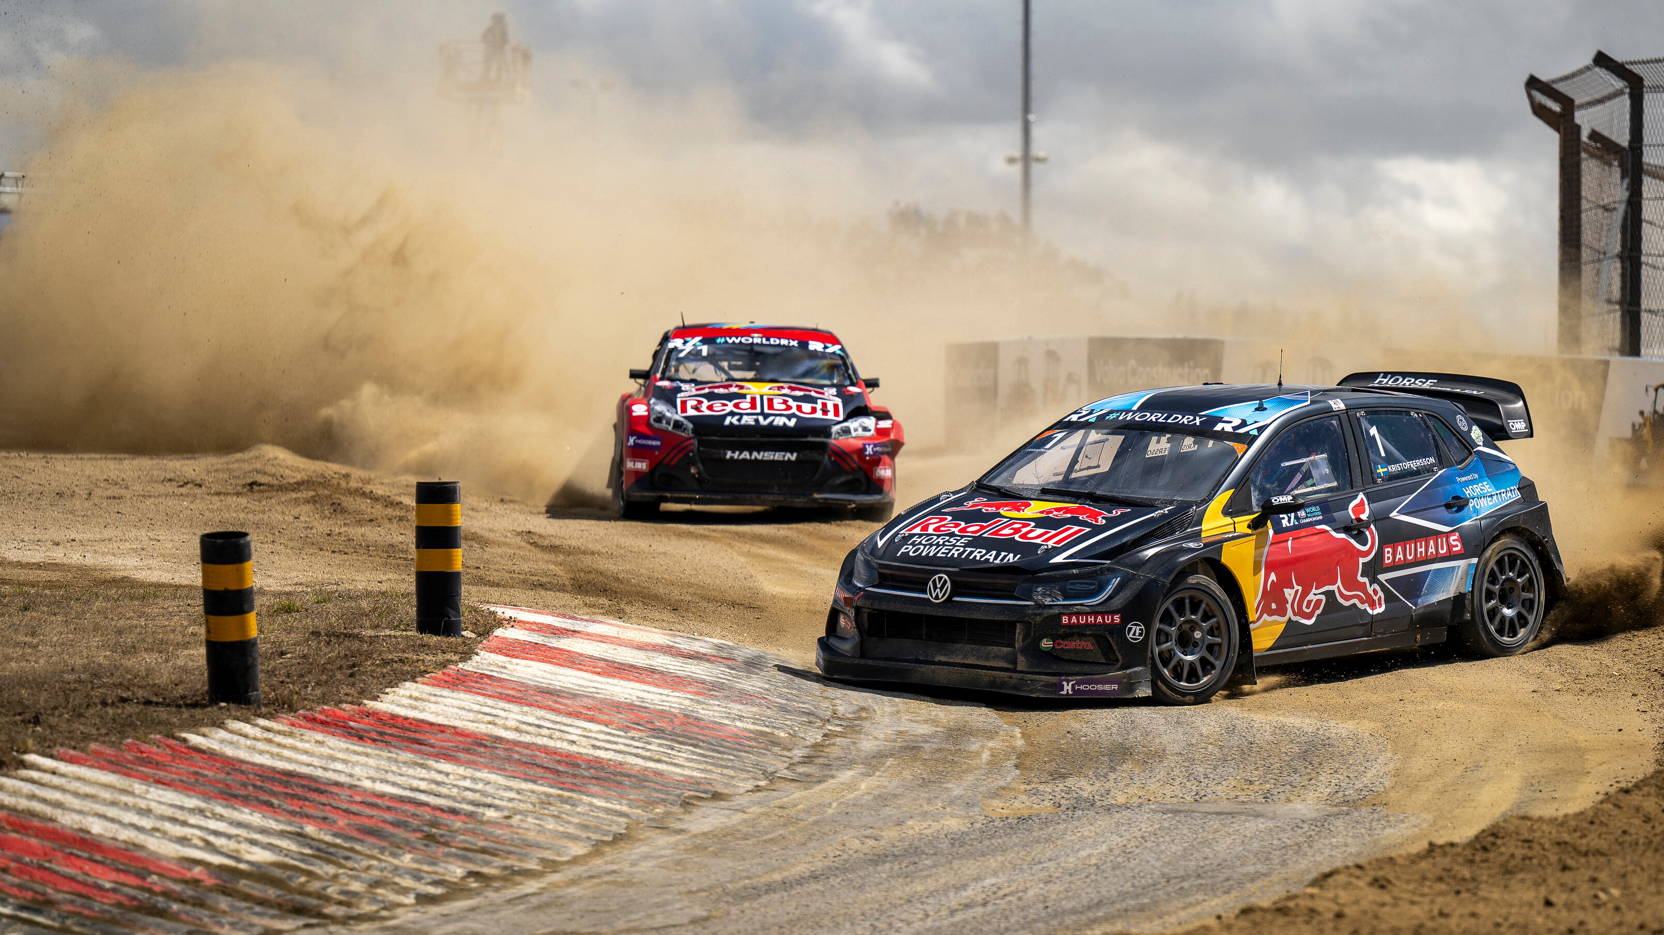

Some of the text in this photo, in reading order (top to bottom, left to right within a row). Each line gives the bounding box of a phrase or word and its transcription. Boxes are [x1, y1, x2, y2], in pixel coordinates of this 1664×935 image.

[715, 336, 799, 347] #WORLDRX
[1374, 373, 1438, 388] HORSE
[676, 393, 843, 421] Red Bull
[723, 414, 797, 428] KEVIN
[1105, 411, 1207, 426] #WORLDRX
[1508, 421, 1526, 430] OMP
[724, 450, 798, 461] HANSEN
[1387, 456, 1436, 472] KRISTOFFERSSON
[1462, 481, 1493, 498] HORSE
[1468, 484, 1521, 511] POWERTRAIN
[905, 515, 1092, 547] Red Bull
[907, 534, 973, 547] HORSE
[896, 545, 1021, 564] POWERTRAIN
[1383, 532, 1464, 567] BAUHAUS
[1061, 614, 1121, 625] BAUHAUS
[1054, 639, 1094, 650] Castro
